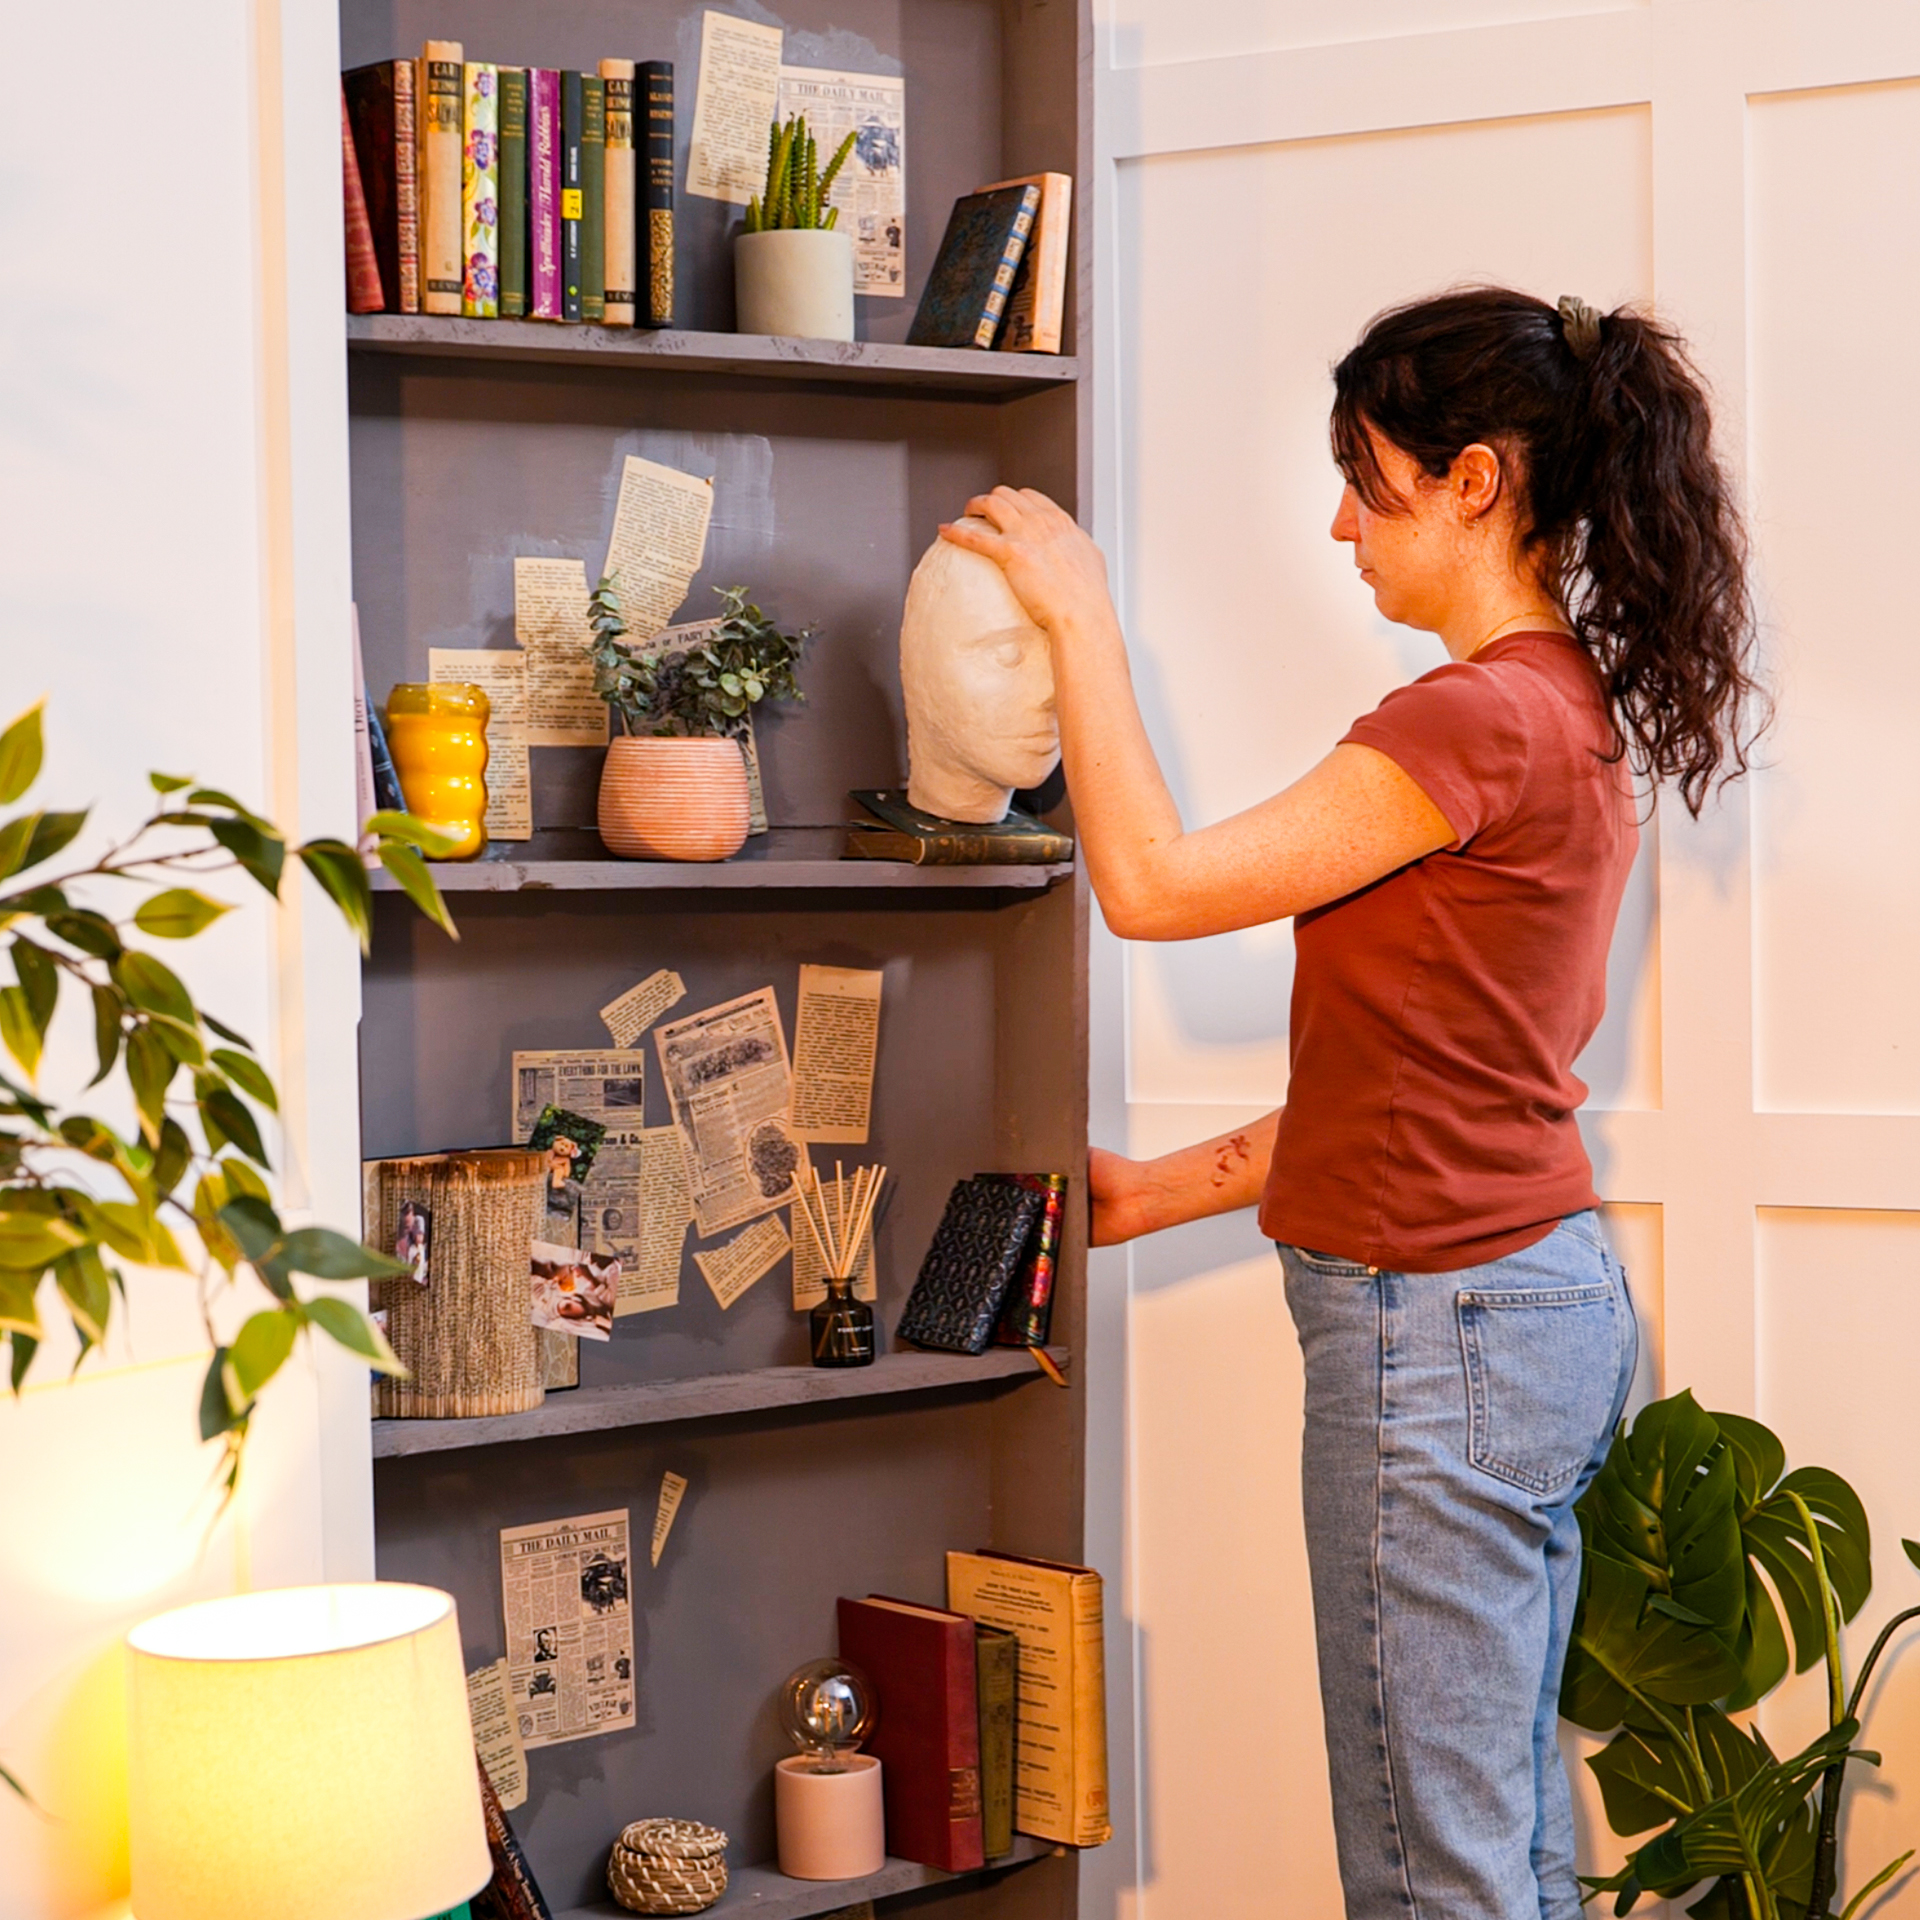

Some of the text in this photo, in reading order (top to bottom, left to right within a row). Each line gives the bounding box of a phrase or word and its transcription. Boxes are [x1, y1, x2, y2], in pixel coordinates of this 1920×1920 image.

[797, 83, 885, 102] THE DAILY MAIL
[678, 631, 704, 645] FAIRY
[559, 1066, 595, 1077] EVERYTHING
[597, 1064, 608, 1075] FOR
[611, 1064, 621, 1075] THE
[621, 1133, 627, 1145] &
[520, 1527, 611, 1554] THE DAILY MAIL
